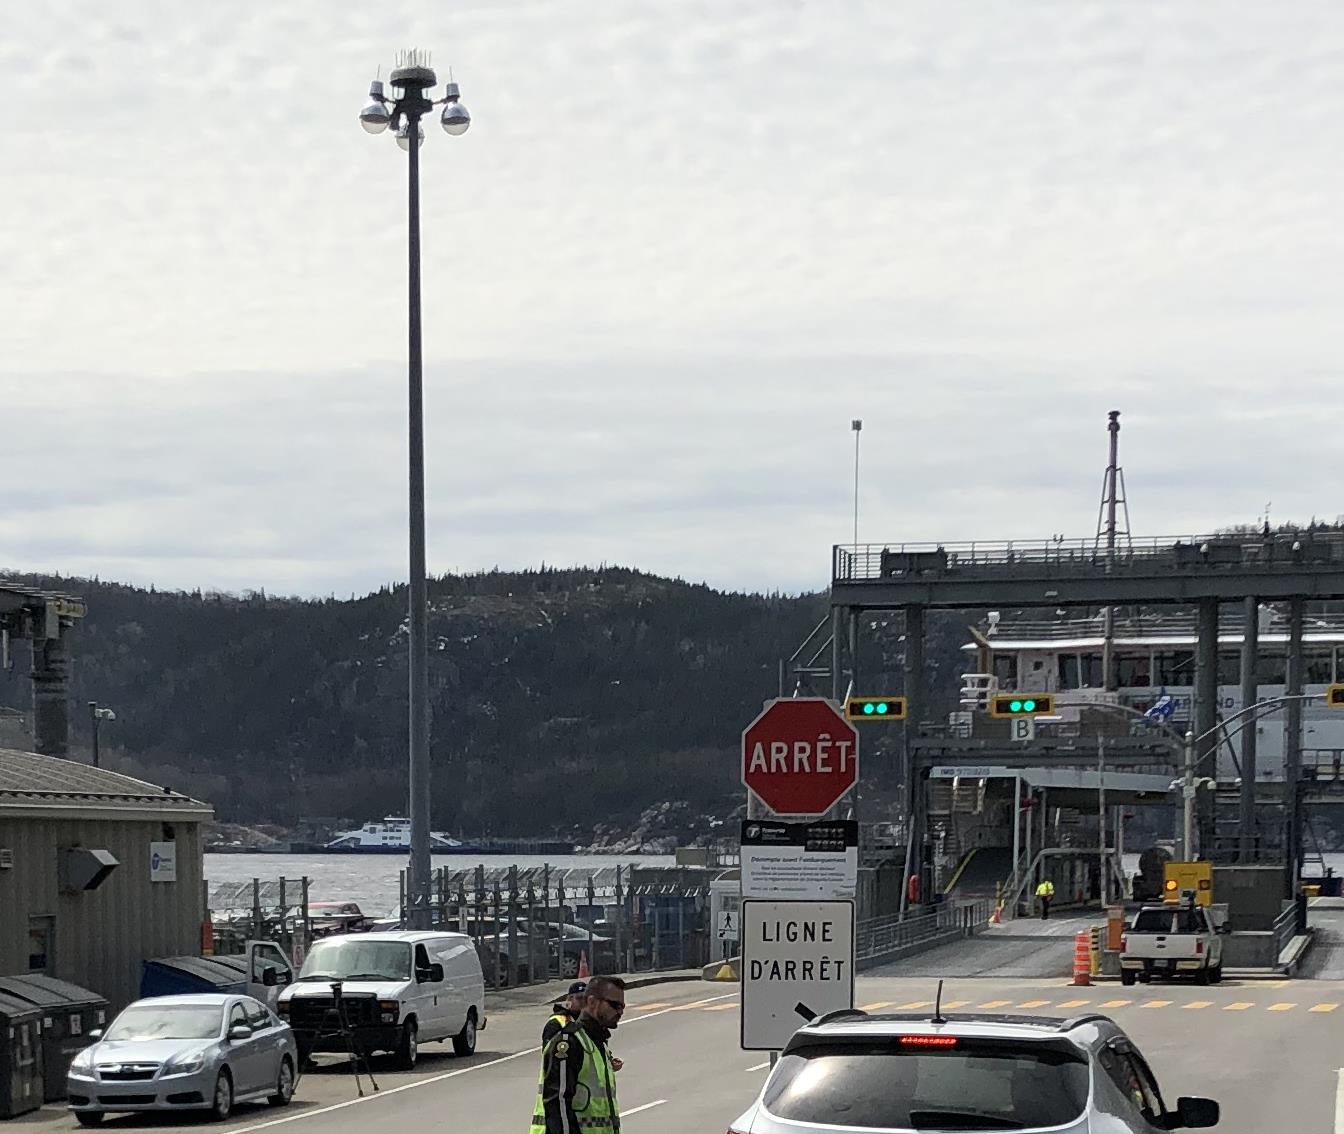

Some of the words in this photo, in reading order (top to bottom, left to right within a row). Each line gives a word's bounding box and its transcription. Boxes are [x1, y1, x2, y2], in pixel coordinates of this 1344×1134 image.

[1017, 720, 1030, 738] B
[749, 733, 851, 773] ARRÊT
[762, 921, 833, 942] LIGNE
[750, 956, 844, 981] D'ARRÊT
